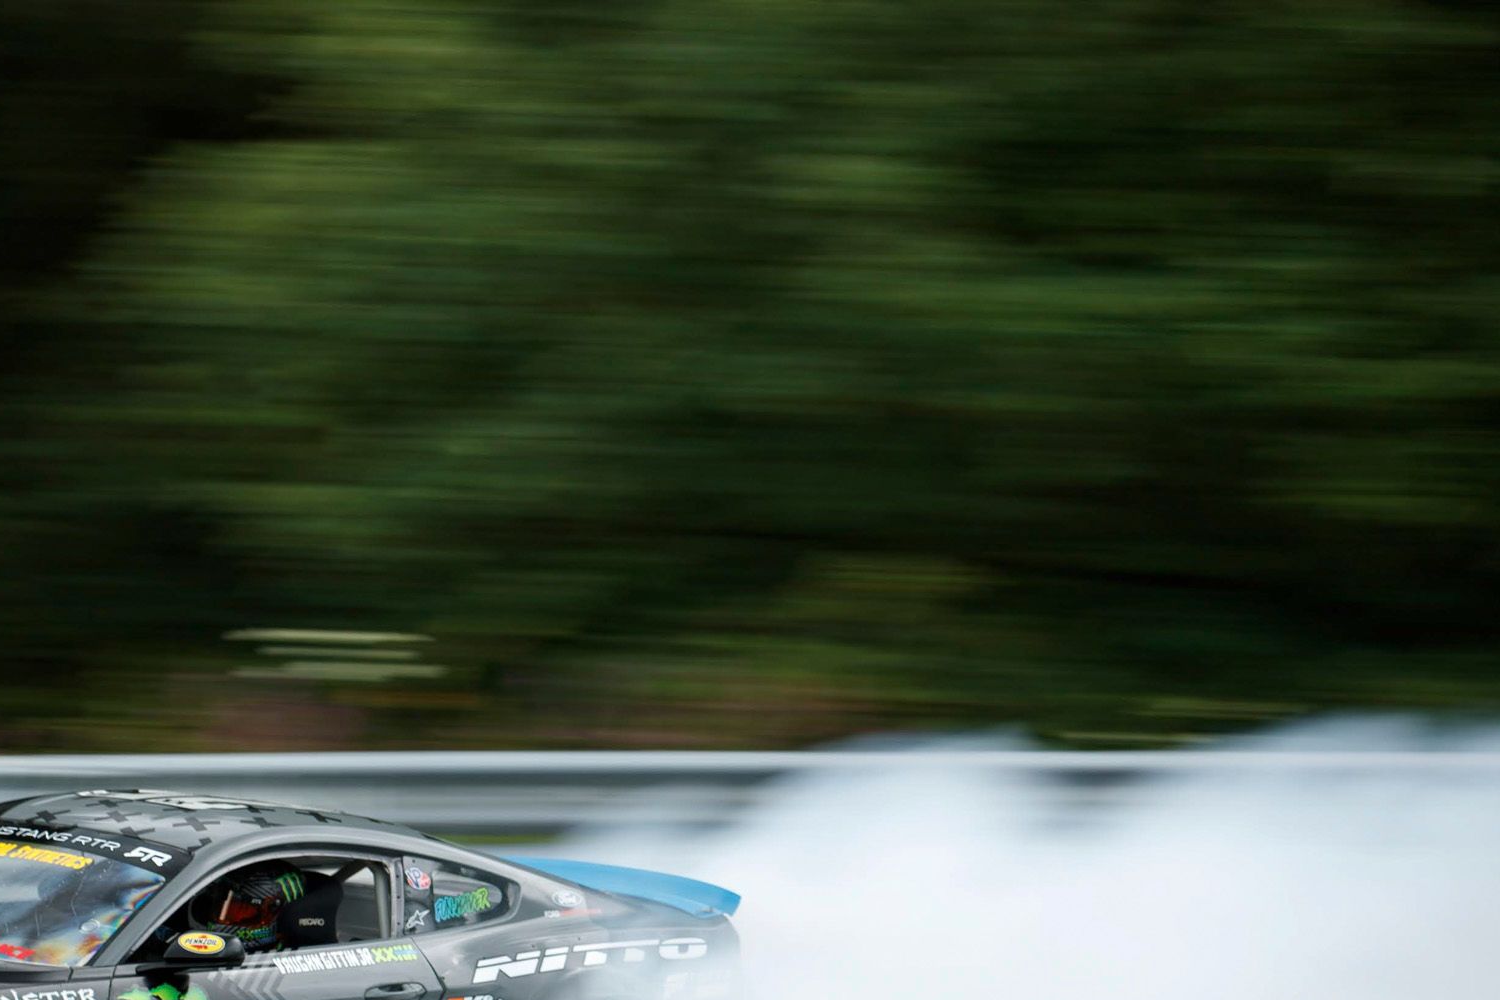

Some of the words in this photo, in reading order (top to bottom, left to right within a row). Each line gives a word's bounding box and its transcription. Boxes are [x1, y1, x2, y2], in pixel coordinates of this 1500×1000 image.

[71, 834, 121, 852] RTR
[184, 938, 218, 947] PENNZOIL
[272, 952, 325, 974] VAUGHN
[320, 949, 361, 970] GITTIN
[357, 947, 376, 967] JR
[472, 937, 707, 984] NITTO
